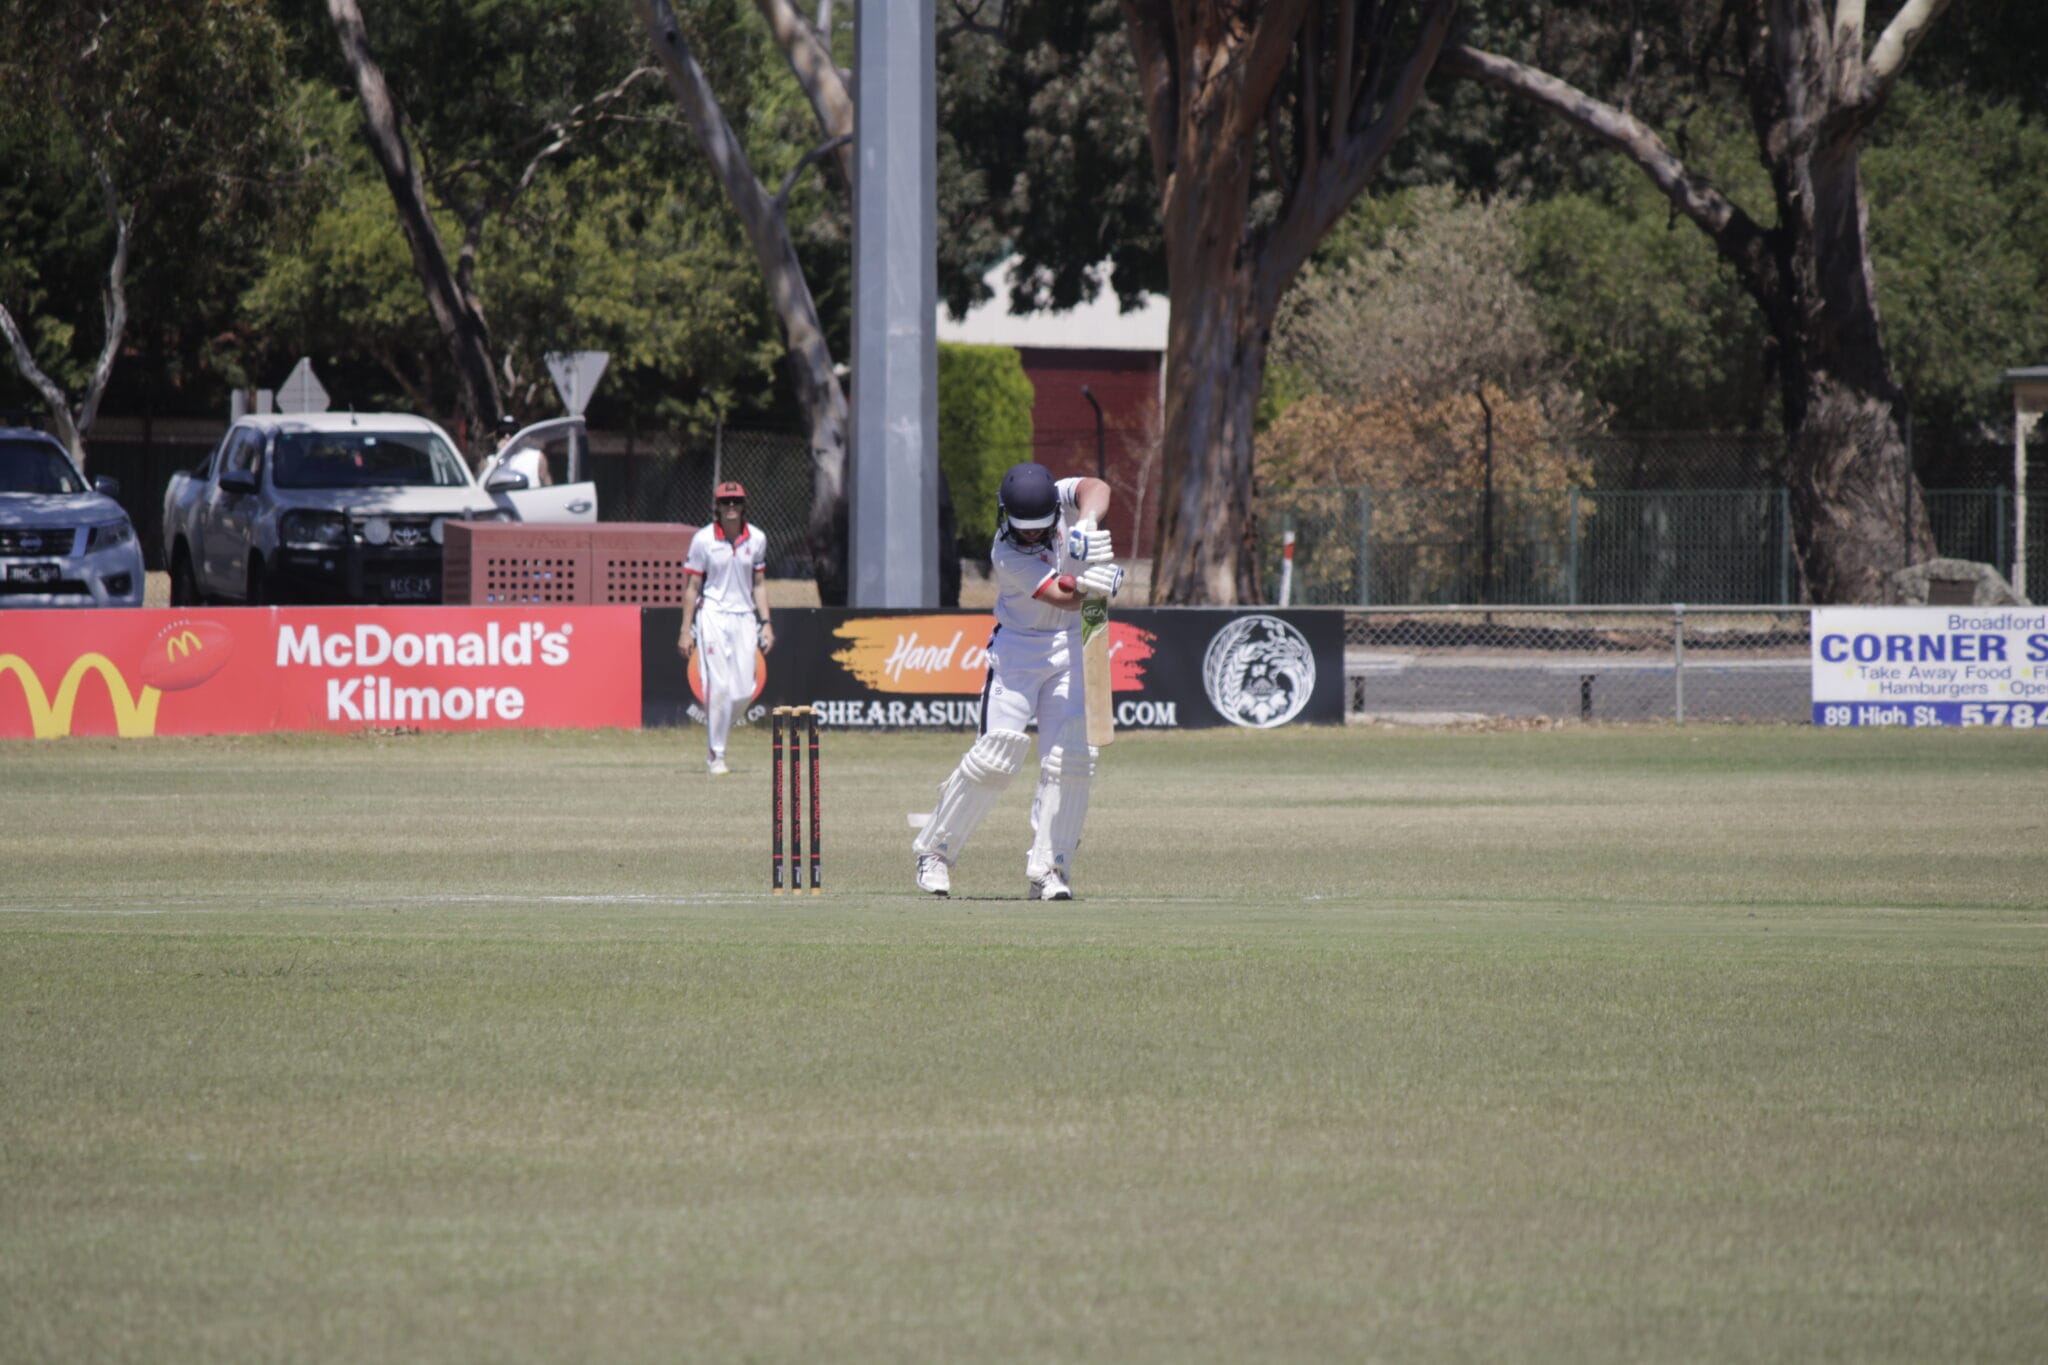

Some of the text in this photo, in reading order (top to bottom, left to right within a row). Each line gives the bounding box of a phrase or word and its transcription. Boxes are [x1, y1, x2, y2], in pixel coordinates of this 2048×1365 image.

[1948, 614, 2045, 630] Broadford
[277, 623, 570, 667] McDonald's
[884, 631, 963, 683] Hand
[1820, 633, 2007, 663] CORNER
[1858, 665, 1901, 679] Take
[1908, 665, 1958, 681] Away
[1966, 665, 2012, 679] Food
[327, 677, 525, 721] Kilmore
[1880, 680, 2048, 697] Hamburgers Ope
[1824, 706, 1851, 726] 89
[1913, 705, 1942, 727] St.
